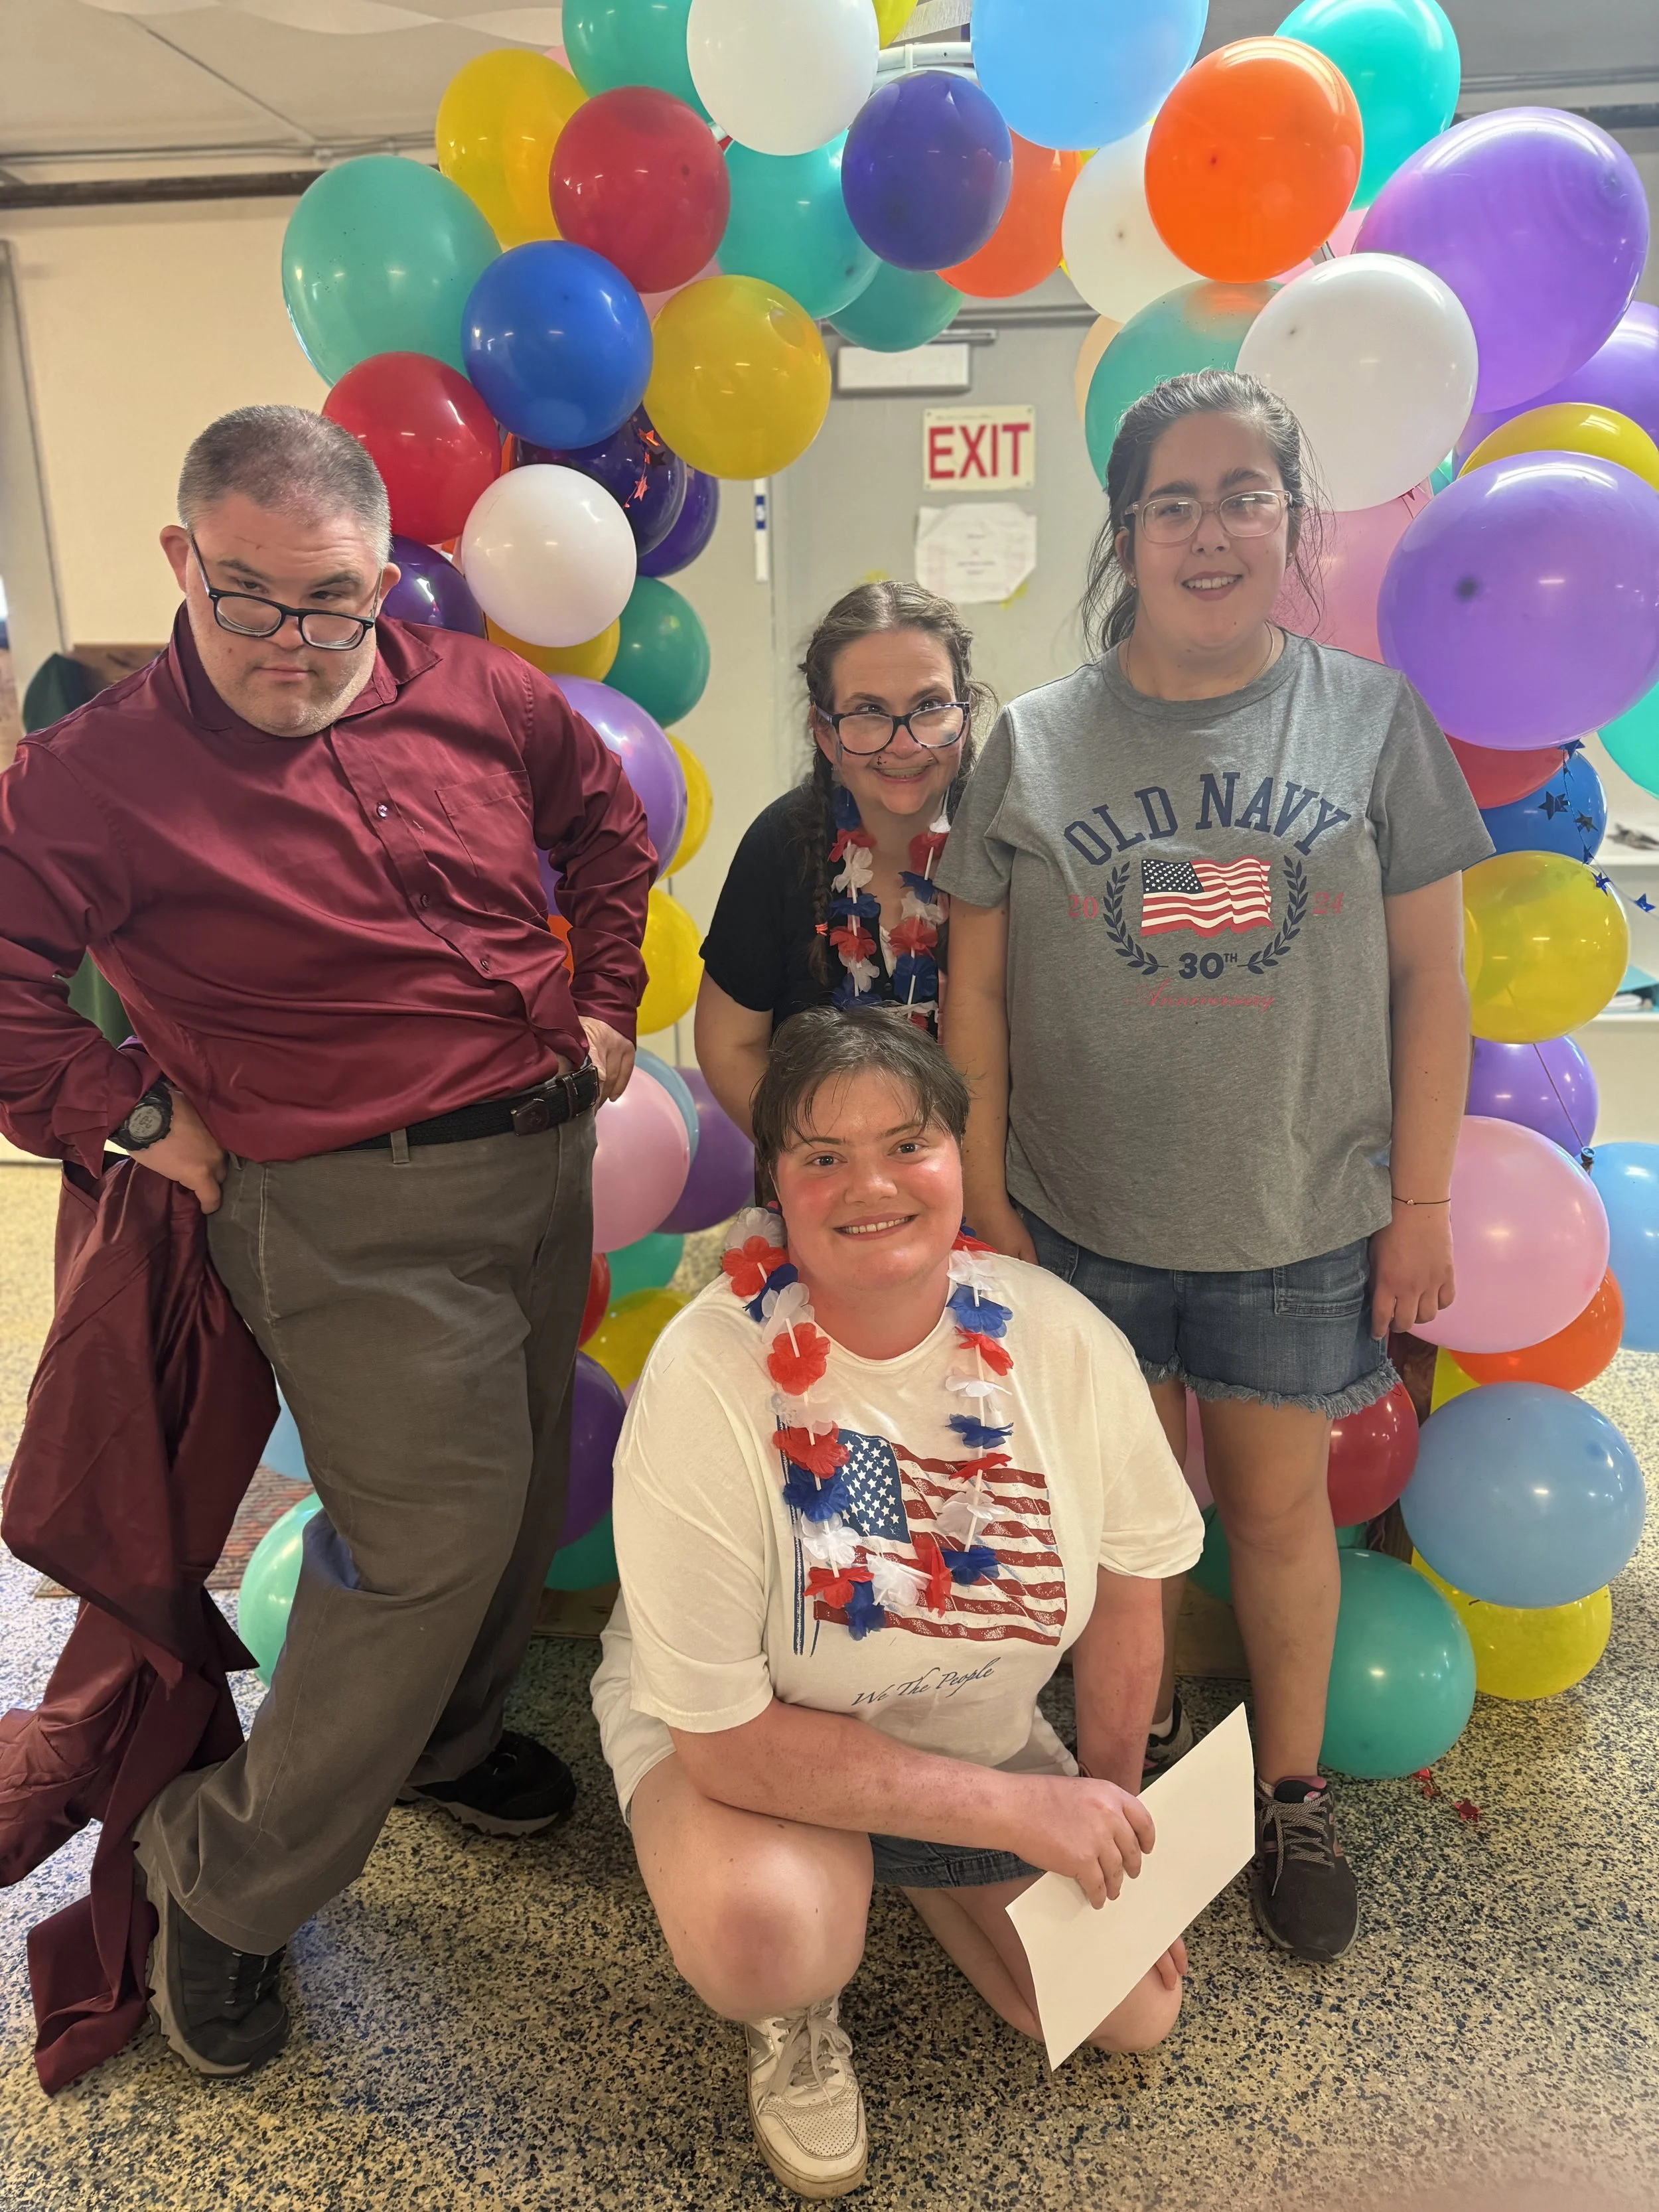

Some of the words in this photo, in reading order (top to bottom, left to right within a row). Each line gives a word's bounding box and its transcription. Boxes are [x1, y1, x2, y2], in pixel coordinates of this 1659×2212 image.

[928, 423, 1031, 480] EXIT
[1064, 786, 1178, 865] OLD
[1195, 772, 1352, 856] NAVY
[1068, 895, 1098, 919] 20
[1312, 892, 1344, 915] 24
[1128, 977, 1275, 1017] Anniversary
[851, 1684, 895, 1706] We
[897, 1666, 940, 1696] The
[936, 1657, 1001, 1698] People
